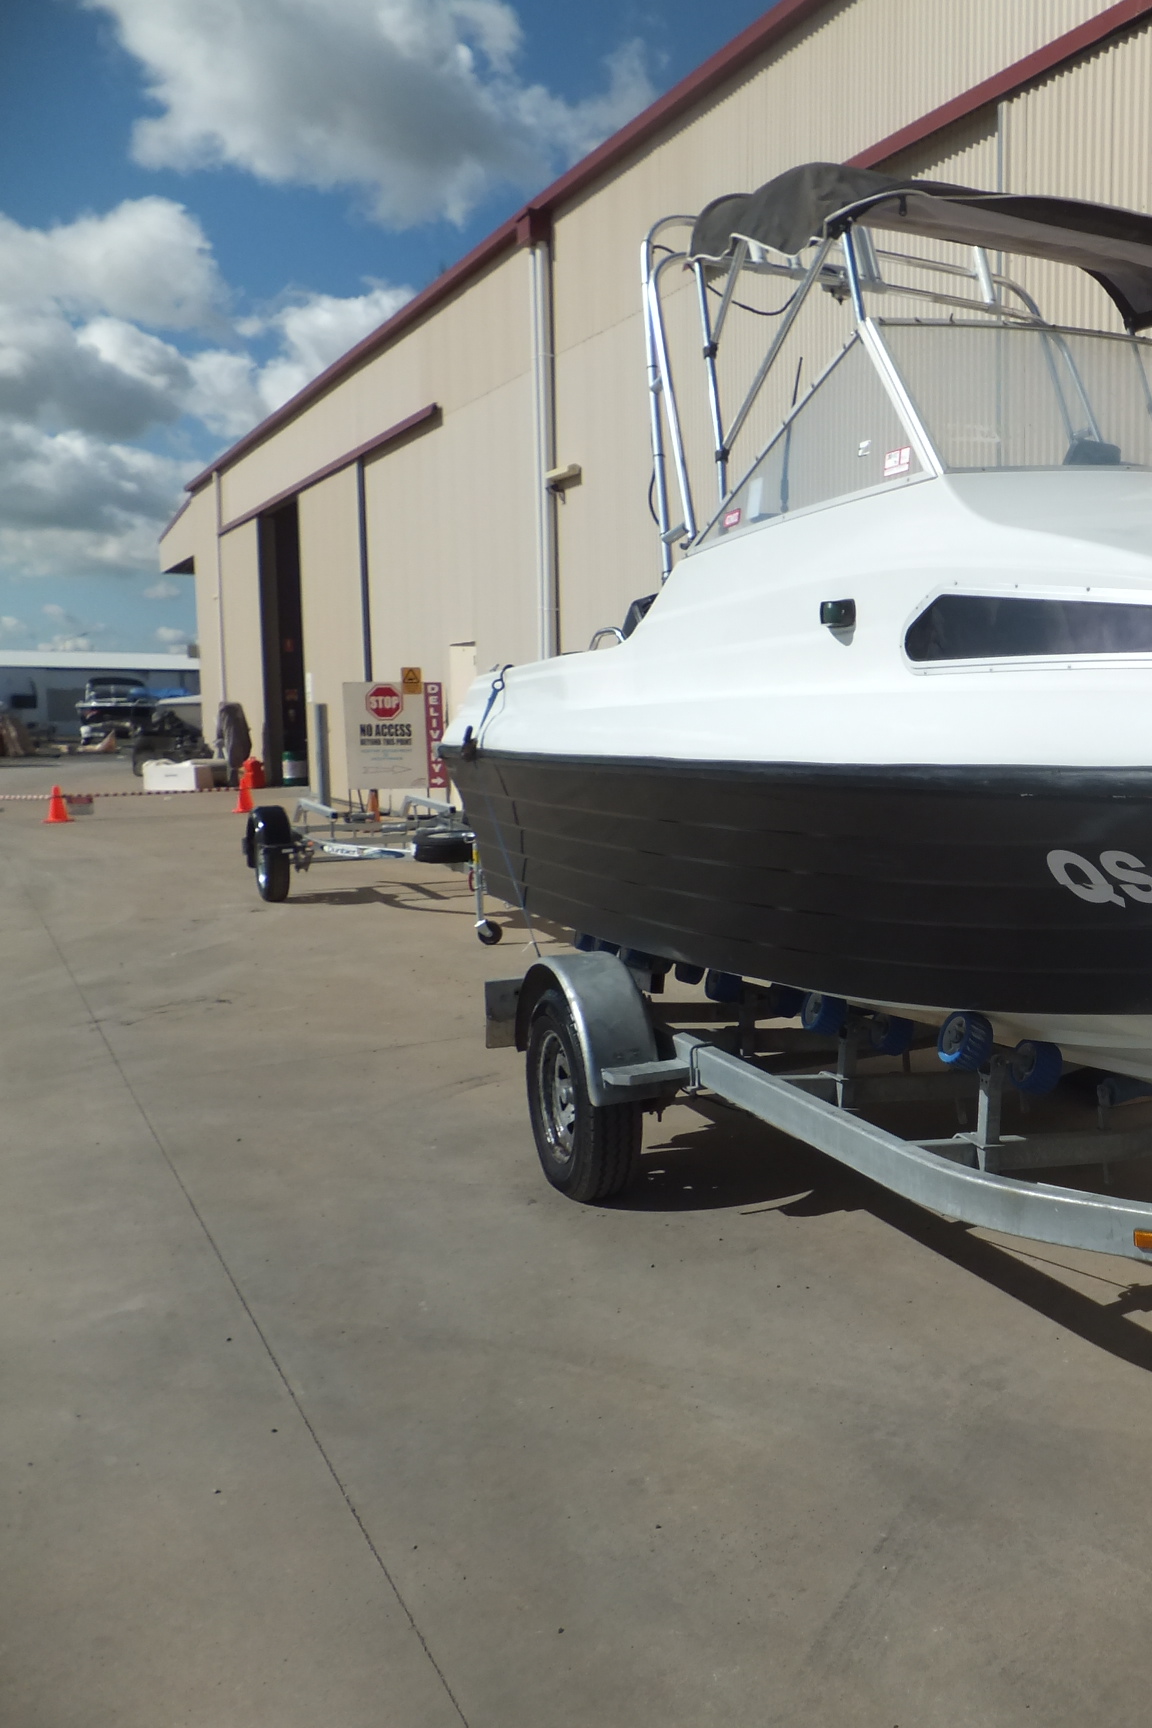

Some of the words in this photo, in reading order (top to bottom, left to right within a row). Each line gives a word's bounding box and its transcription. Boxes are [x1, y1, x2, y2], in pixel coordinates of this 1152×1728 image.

[369, 696, 400, 709] STOP
[360, 724, 372, 736] NO
[375, 724, 412, 737] ACCESS
